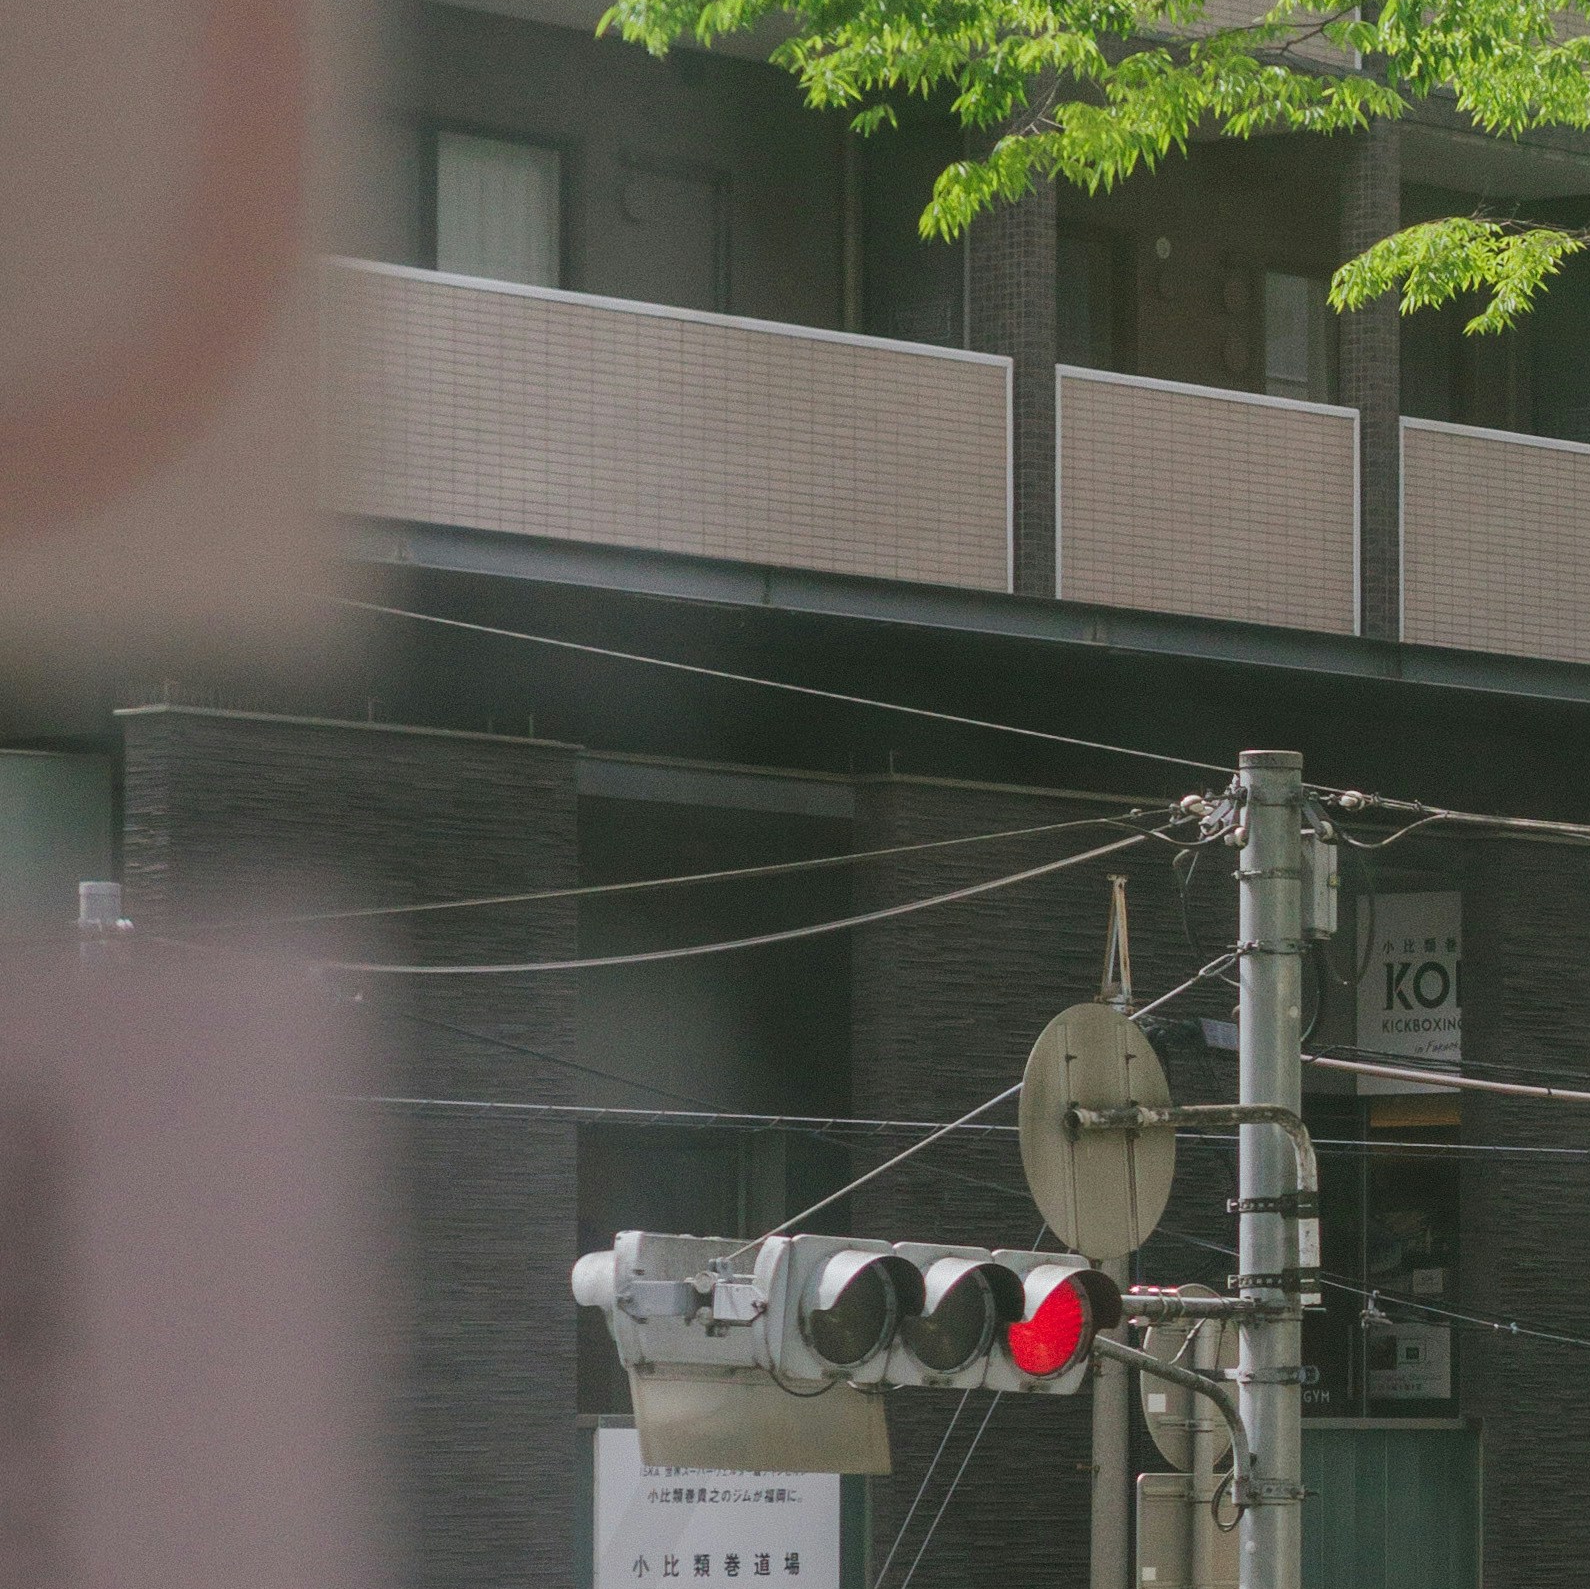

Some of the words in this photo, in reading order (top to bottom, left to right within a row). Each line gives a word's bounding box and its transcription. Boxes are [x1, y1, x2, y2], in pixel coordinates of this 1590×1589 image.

[1303, 1391, 1330, 1403] GYM
[632, 1552, 801, 1578] 小比類巻道場
